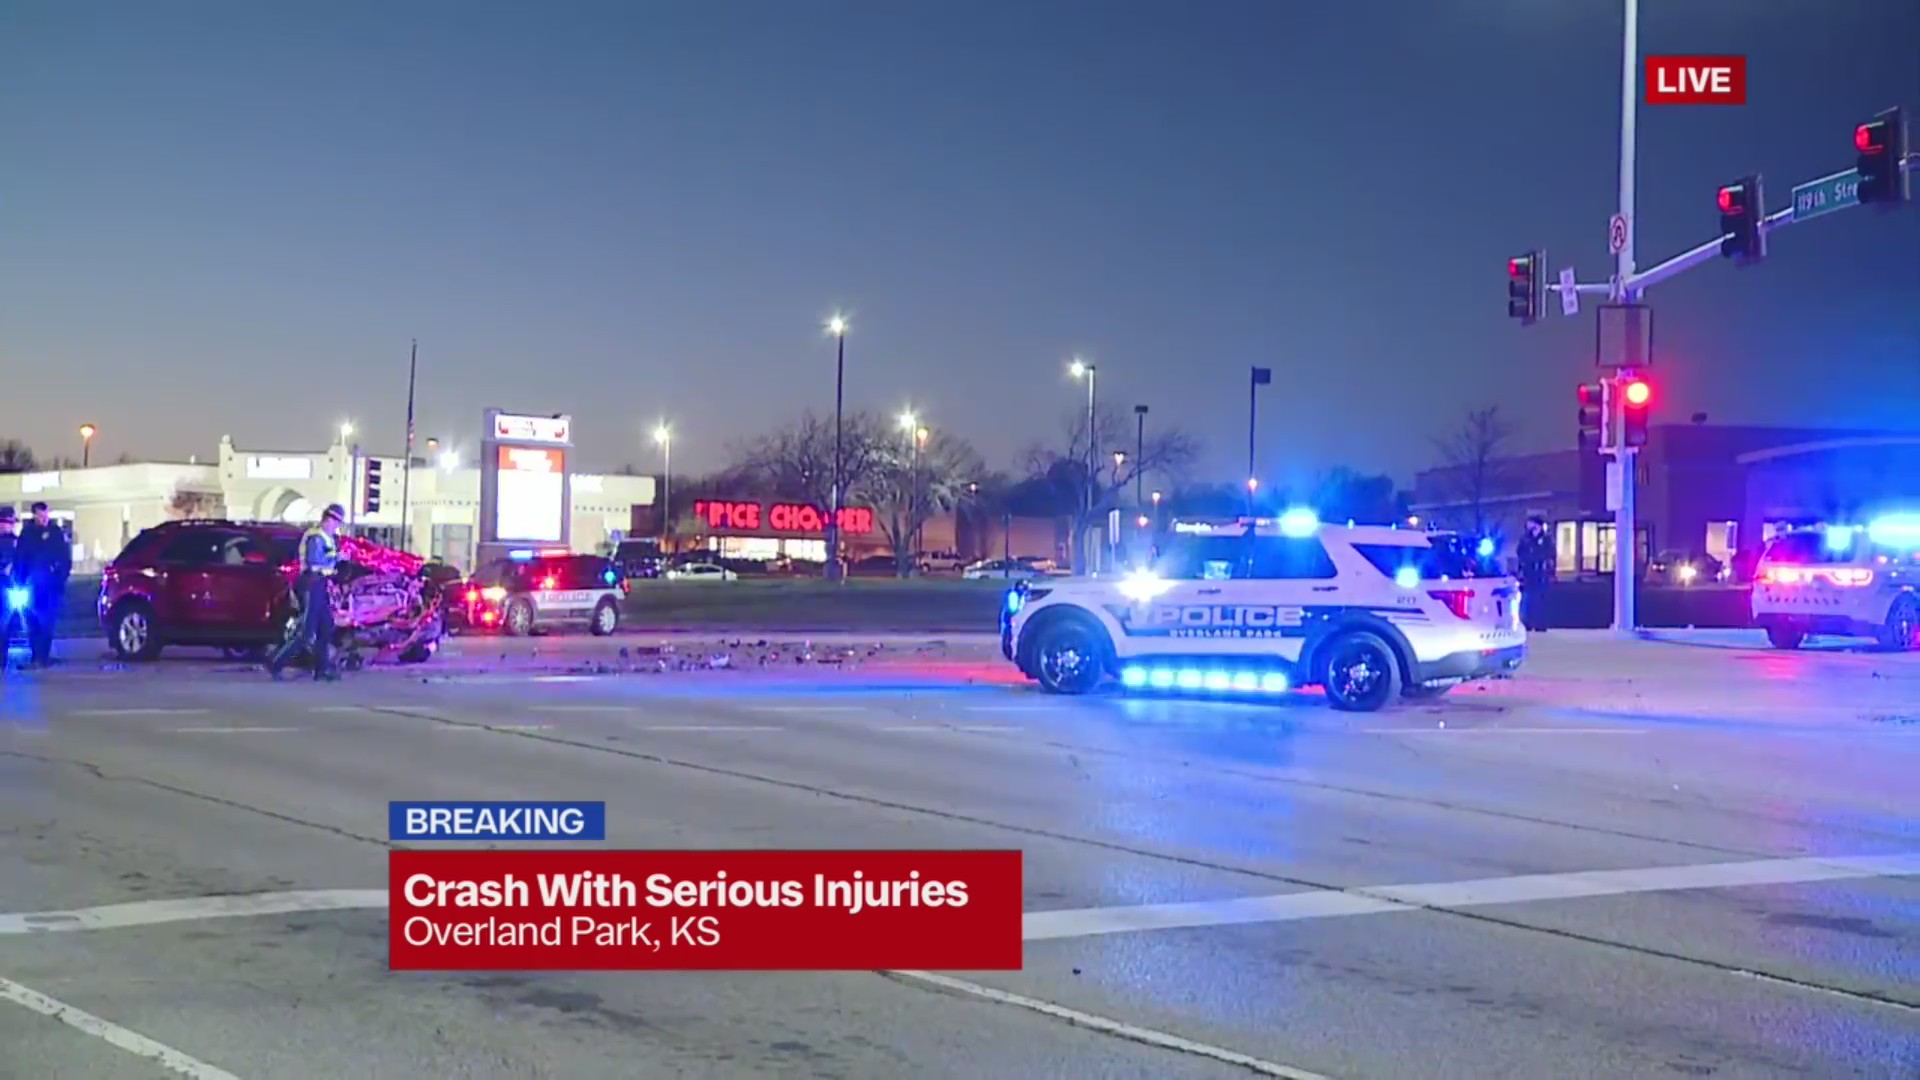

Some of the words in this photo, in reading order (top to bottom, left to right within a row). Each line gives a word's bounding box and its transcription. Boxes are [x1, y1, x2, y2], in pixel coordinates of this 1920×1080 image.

[1834, 182, 1858, 202] Stre
[1154, 606, 1302, 627] POLICE
[1170, 629, 1240, 638] OVERLAND
[1246, 629, 1282, 638] PARK
